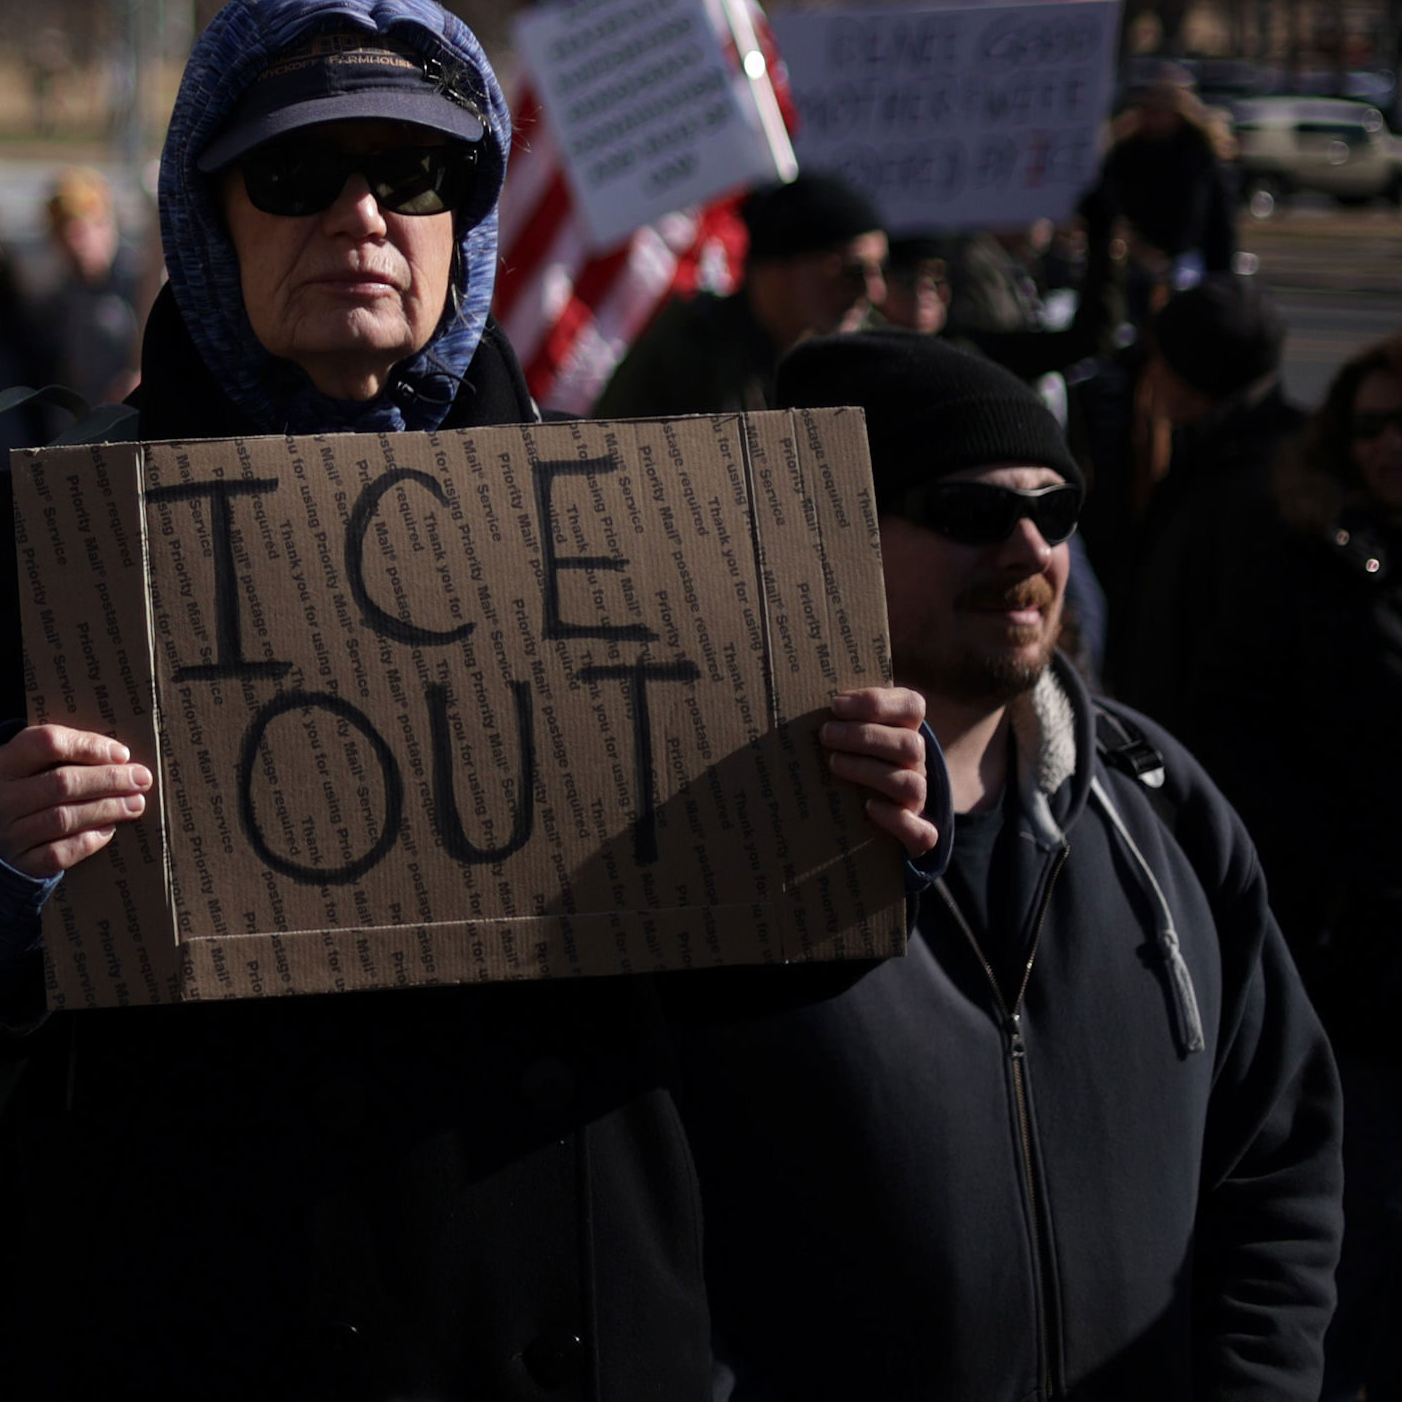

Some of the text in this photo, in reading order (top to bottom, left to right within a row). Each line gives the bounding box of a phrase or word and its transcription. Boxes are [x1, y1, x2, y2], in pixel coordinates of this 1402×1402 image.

[326, 54, 416, 71] FARMHOUSE
[474, 483, 501, 543] Service
[495, 451, 522, 512] Priority
[617, 474, 643, 535] Service
[677, 470, 709, 538] required
[757, 467, 784, 527] Service
[818, 463, 849, 529] required
[42, 506, 69, 566] Service
[104, 501, 136, 569] required
[187, 498, 214, 559] Service
[249, 492, 281, 561] required
[277, 519, 303, 569] Thank
[393, 486, 424, 553] required
[421, 511, 448, 562] Thank
[145, 455, 659, 682] ICE
[167, 538, 193, 599] Priority
[289, 457, 305, 483] for
[297, 485, 319, 530] using
[312, 531, 338, 592] Priority
[343, 637, 371, 699] Service
[433, 449, 449, 475] for
[441, 476, 463, 522] using
[456, 523, 482, 583] Priority
[488, 628, 515, 689] Service
[434, 564, 454, 594] you
[563, 504, 606, 614] Thank for
[638, 444, 665, 504] Priority
[669, 549, 699, 613] postage
[692, 616, 724, 684] required
[715, 435, 731, 461] for
[724, 463, 745, 507] using
[773, 613, 800, 674] Service
[65, 473, 92, 534] Priority
[94, 581, 124, 645] postage
[114, 649, 146, 716] required
[237, 573, 268, 638] postage
[290, 572, 310, 603] you
[302, 604, 318, 630] for
[447, 596, 463, 622] for
[795, 581, 821, 641] Priority
[20, 546, 47, 607] Priority
[51, 654, 78, 714] Service
[75, 621, 102, 682] Priority
[309, 632, 331, 677] using
[705, 496, 813, 820] Thank you for using Service
[833, 608, 865, 675] required
[468, 670, 495, 731] Priority
[653, 589, 680, 650] Priority
[680, 696, 710, 760] postage
[155, 612, 171, 638] for
[176, 686, 203, 747] Priority
[208, 794, 235, 855] Service
[395, 712, 426, 776] postage
[435, 659, 487, 817] Thank you for using
[509, 597, 536, 658] Priority
[538, 705, 568, 769] postage
[560, 772, 591, 839] required
[240, 652, 703, 887] OUT
[299, 720, 342, 825] you for using
[589, 704, 631, 808] you for using
[720, 642, 791, 861] Thank you for using Priority
[165, 760, 214, 897] for using Priority
[270, 789, 302, 857] required
[666, 737, 692, 797] Priority
[690, 844, 720, 906] postage
[731, 789, 769, 899] Thank you for
[257, 871, 287, 934] postage
[299, 815, 339, 927] Thank for
[548, 853, 578, 916] postage
[600, 851, 620, 881] you
[610, 883, 626, 908] for
[112, 879, 142, 943] postage
[176, 910, 192, 935] for
[467, 892, 483, 917] for
[814, 875, 840, 935] Priority
[95, 918, 122, 980] Priority
[325, 950, 341, 975] for
[469, 940, 484, 965] for
